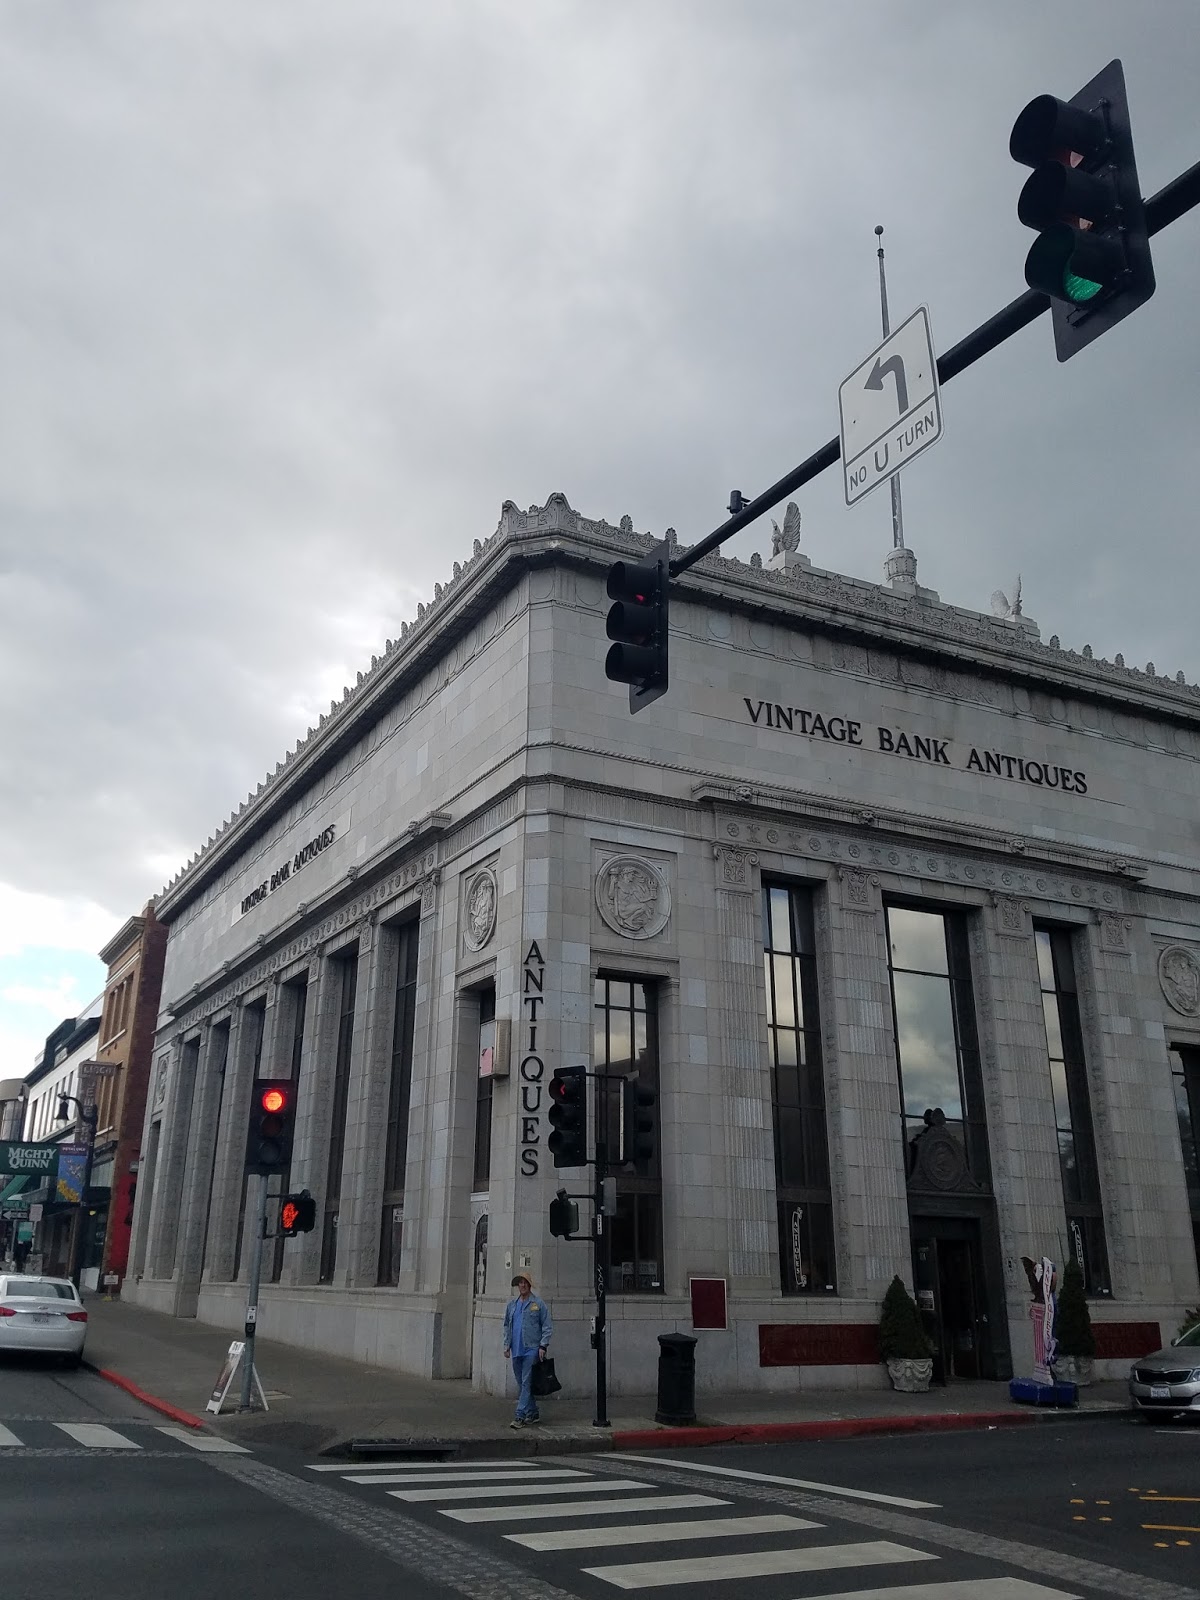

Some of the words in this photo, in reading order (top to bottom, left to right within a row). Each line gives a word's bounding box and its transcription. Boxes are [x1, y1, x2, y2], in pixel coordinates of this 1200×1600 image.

[849, 465, 867, 491] NO
[874, 443, 889, 473] U
[897, 410, 935, 453] TURN
[743, 697, 863, 746] VINTAGE
[877, 726, 952, 765] BANK
[966, 748, 1088, 794] ANTIQUES
[270, 860, 291, 892] BANK
[293, 823, 336, 873] ANTIQUES
[520, 938, 545, 1177] ANTIQUES
[7, 1147, 57, 1159] MIGHTY
[8, 1156, 50, 1169] QUINN
[793, 1221, 801, 1275] ANTIQUES
[1044, 1265, 1054, 1340] ANTIQUES
